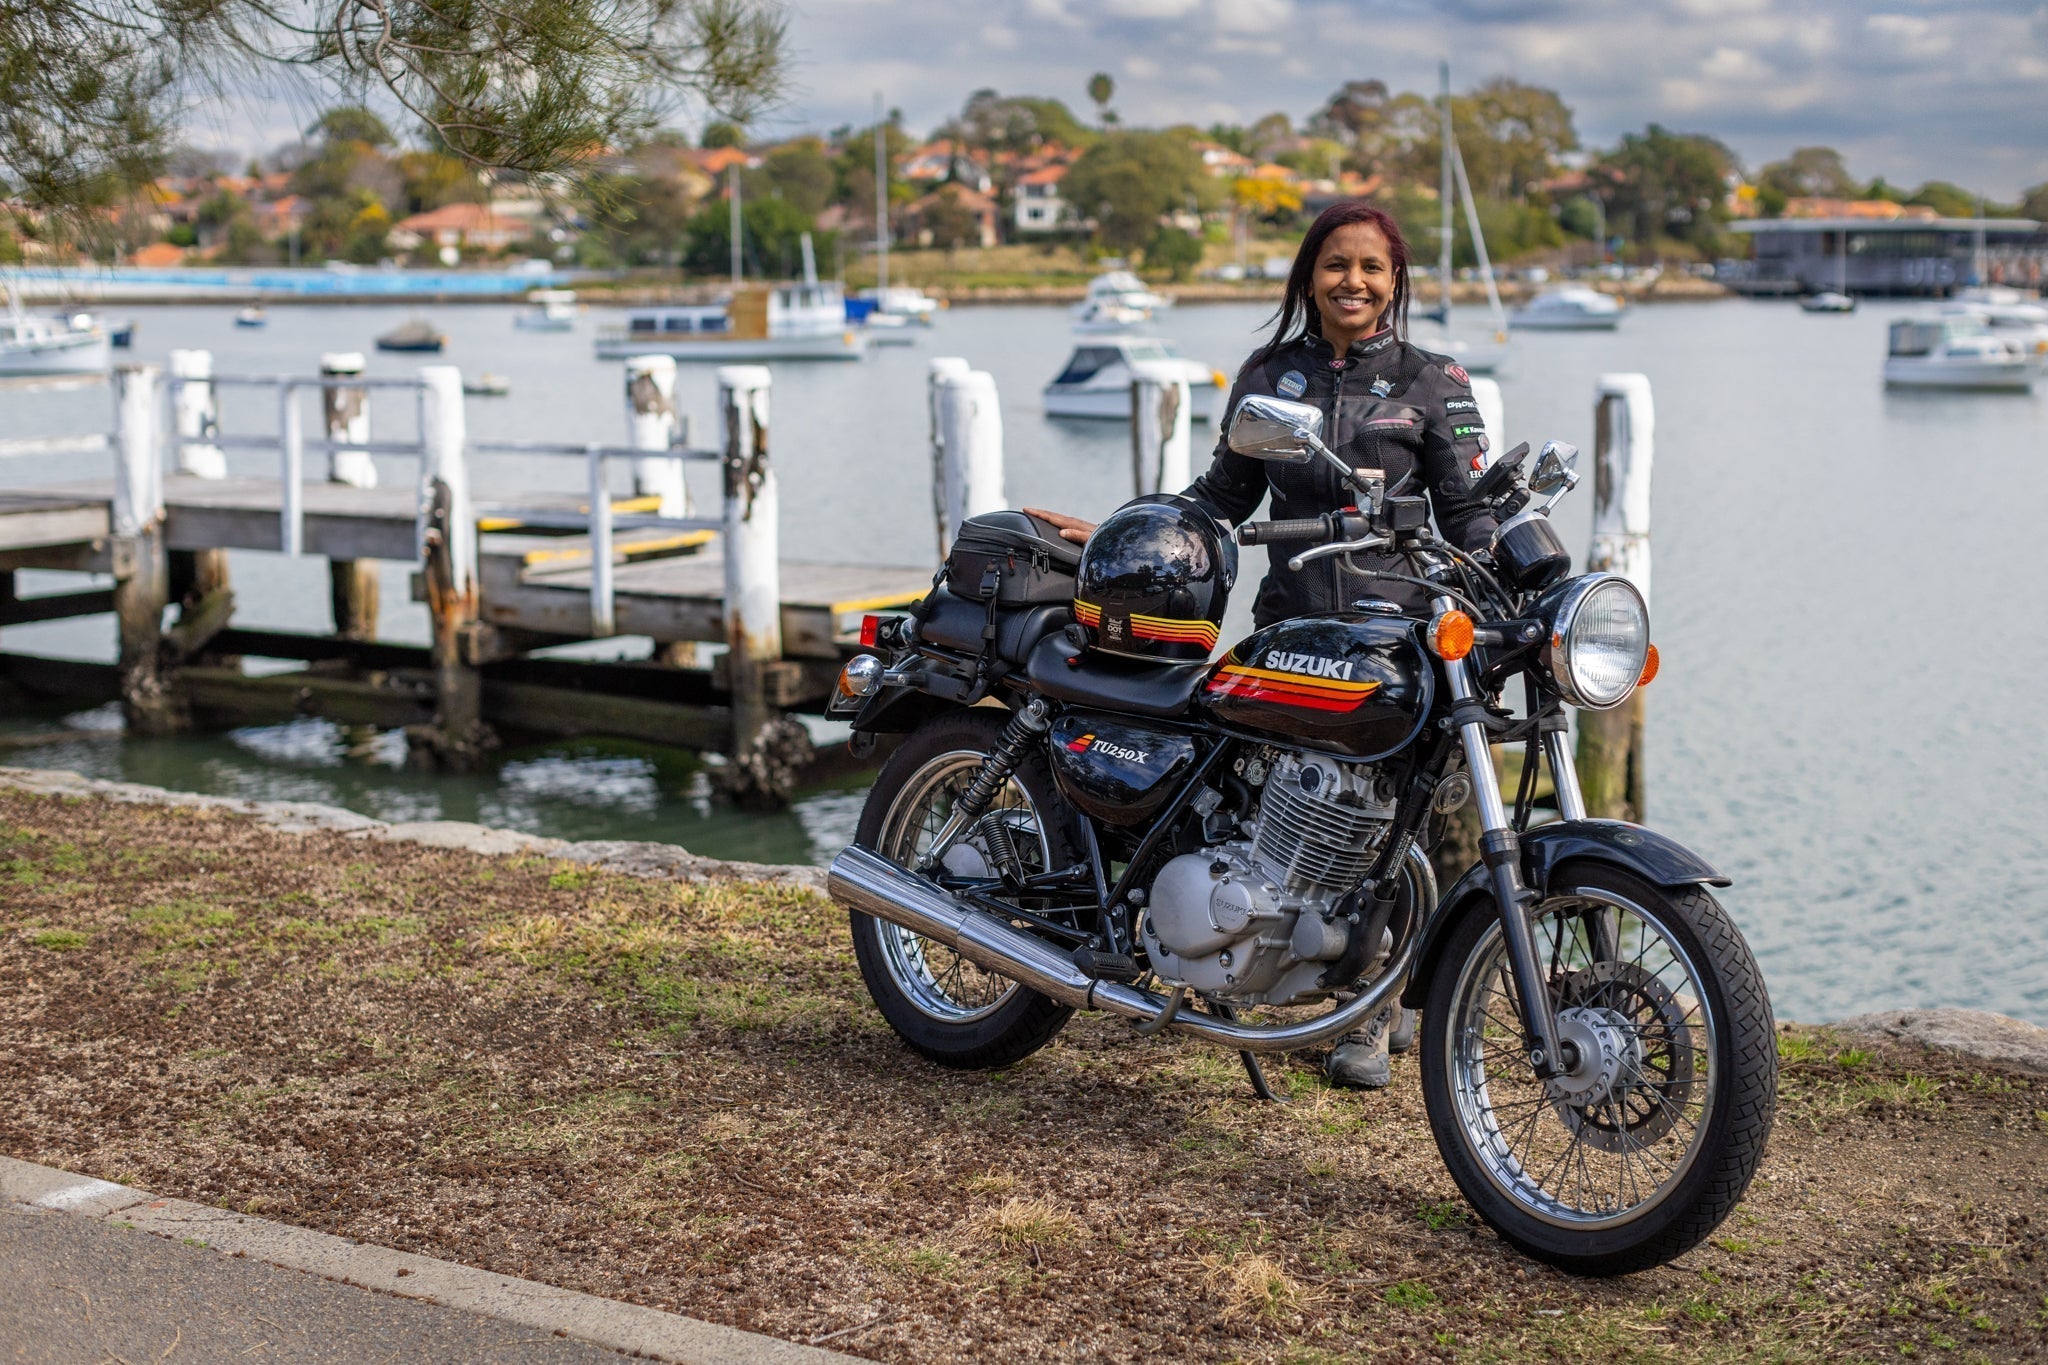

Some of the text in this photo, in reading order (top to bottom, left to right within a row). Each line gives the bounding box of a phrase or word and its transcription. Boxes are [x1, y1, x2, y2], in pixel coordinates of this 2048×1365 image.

[1281, 376, 1303, 392] SUZUKI
[1265, 650, 1353, 681] SUZUKI
[1091, 739, 1150, 765] TU250X
[1215, 898, 1247, 916] SUZUKI
